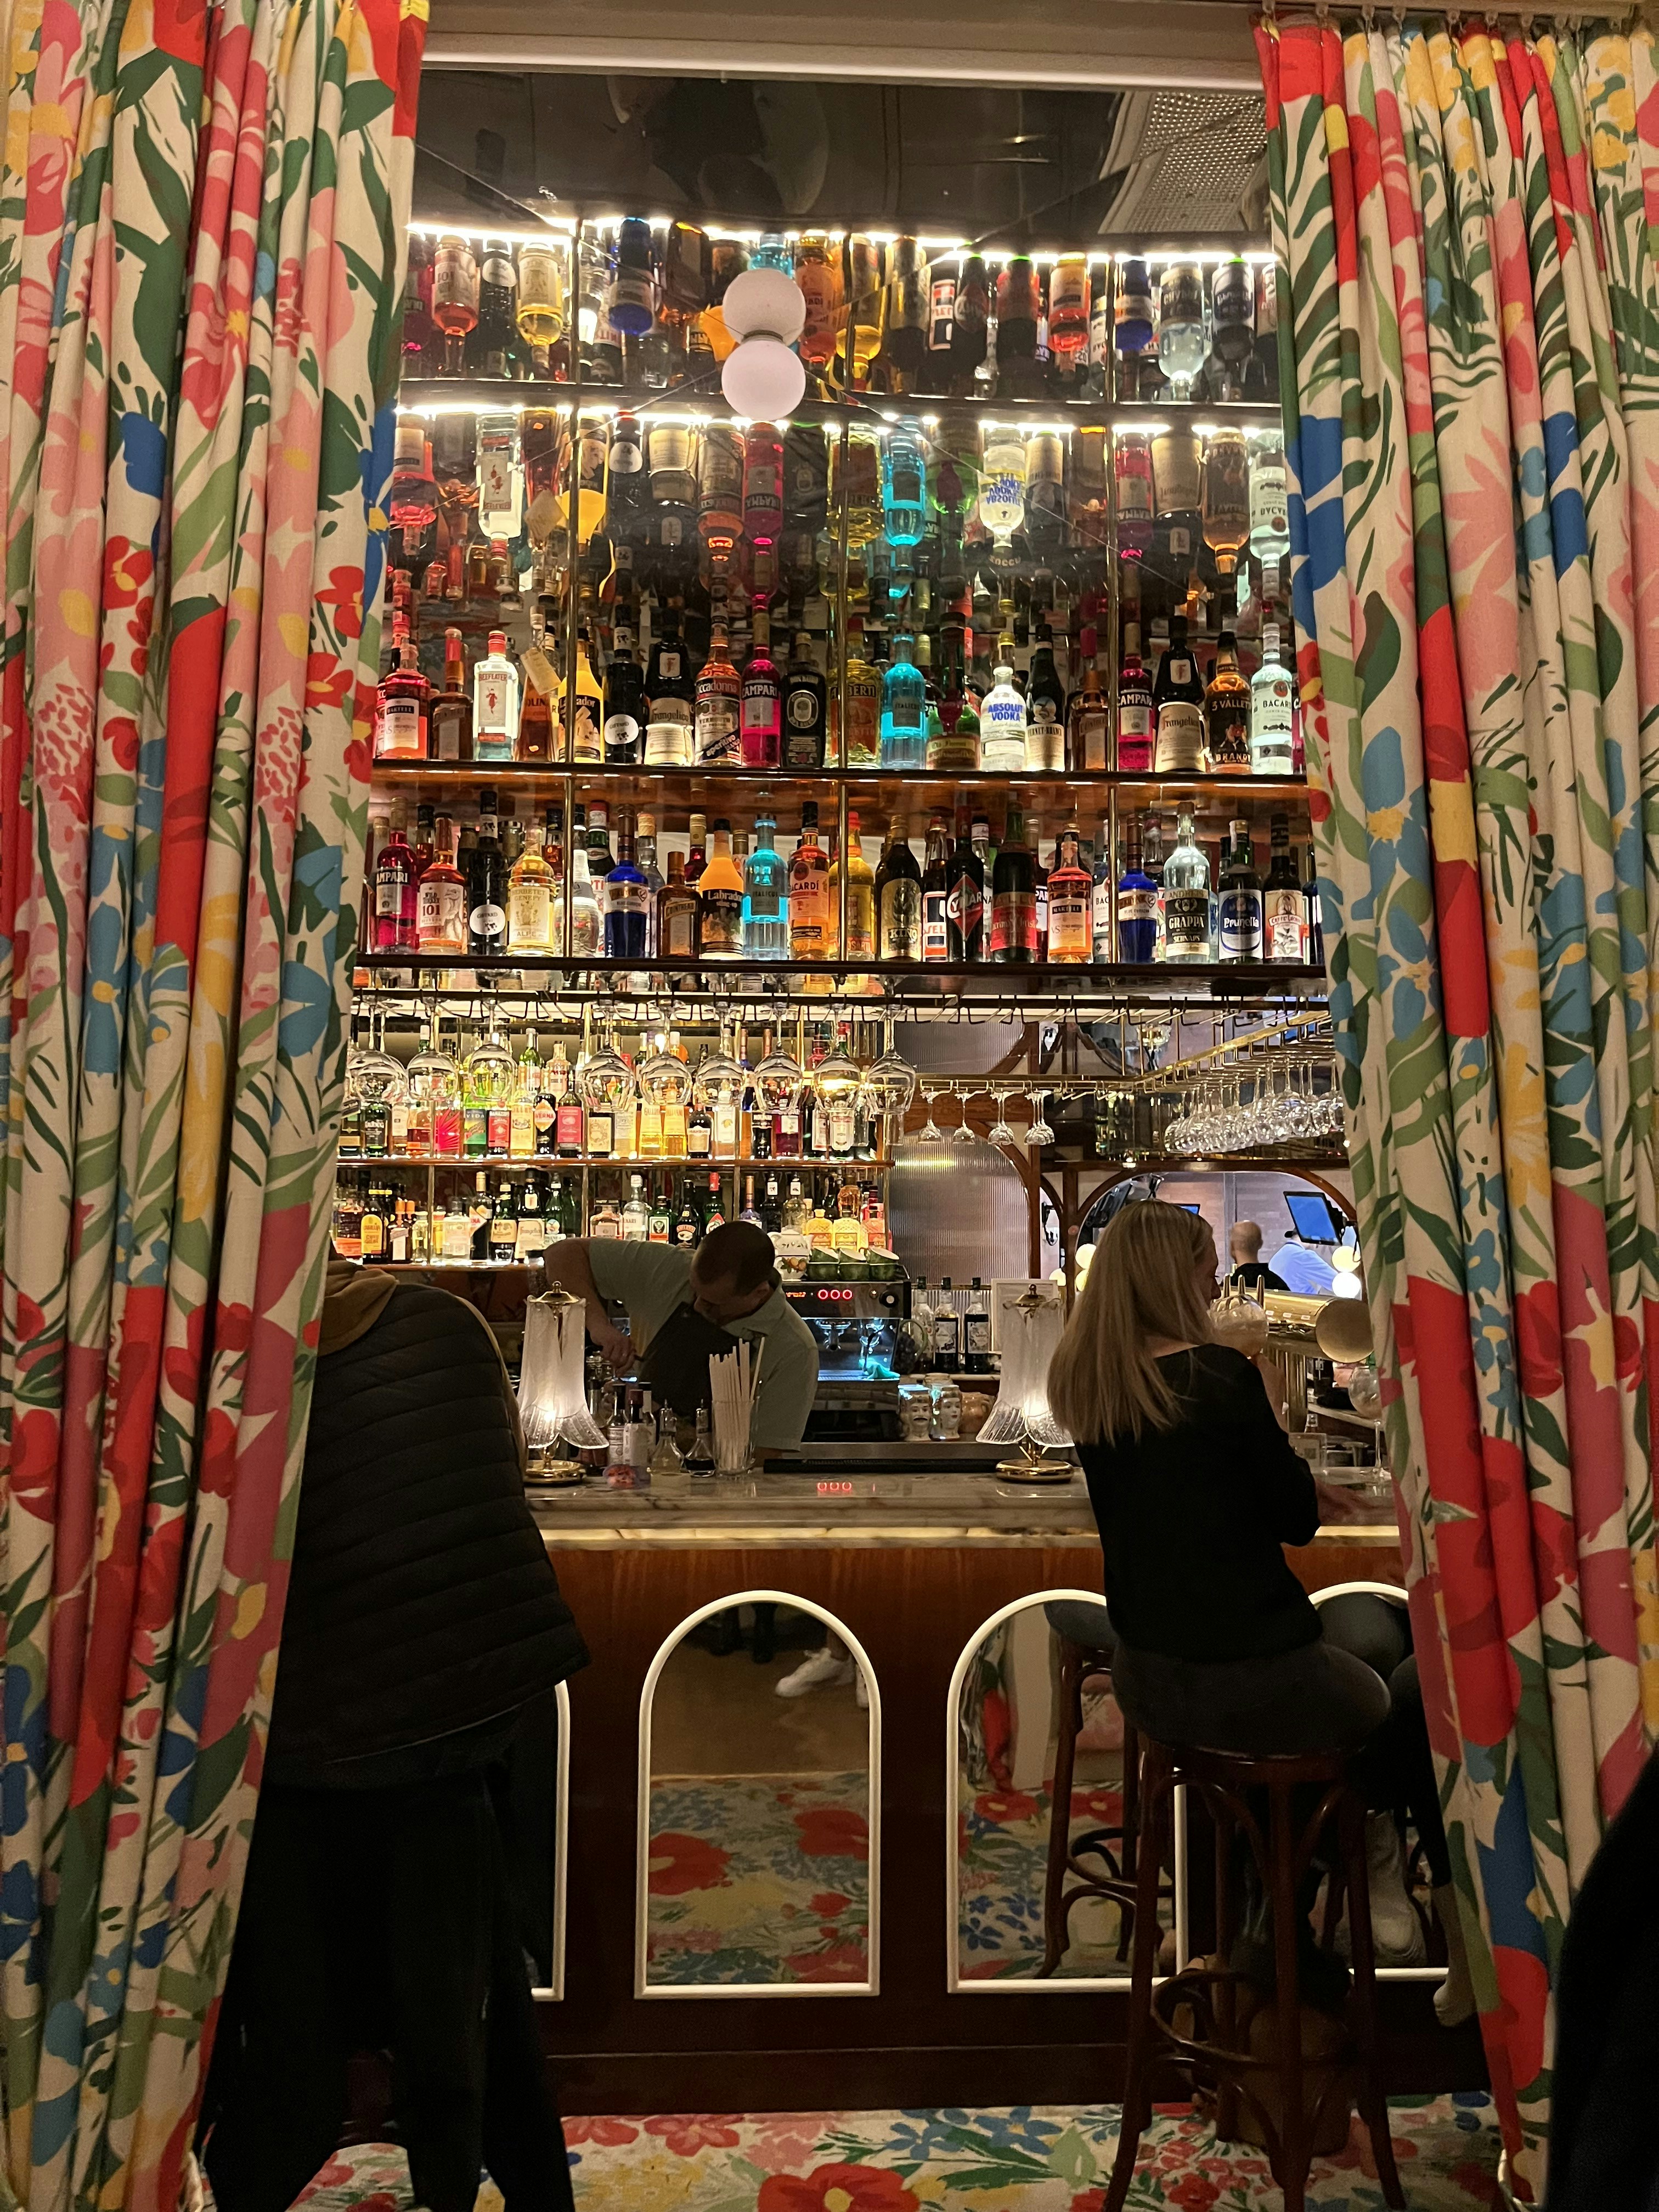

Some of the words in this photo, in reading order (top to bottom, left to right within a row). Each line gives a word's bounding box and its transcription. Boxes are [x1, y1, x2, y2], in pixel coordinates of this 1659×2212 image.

[478, 673, 507, 681] BEEFEATER
[988, 703, 1023, 714] ABSOLUT
[1212, 701, 1218, 712] 3
[652, 708, 689, 724] Frangelico
[991, 712, 1020, 722] VODKA
[377, 871, 408, 883] AMPARI
[422, 905, 441, 916] 101
[1169, 916, 1204, 929] GRAPPA
[1223, 916, 1260, 929] Prunella
